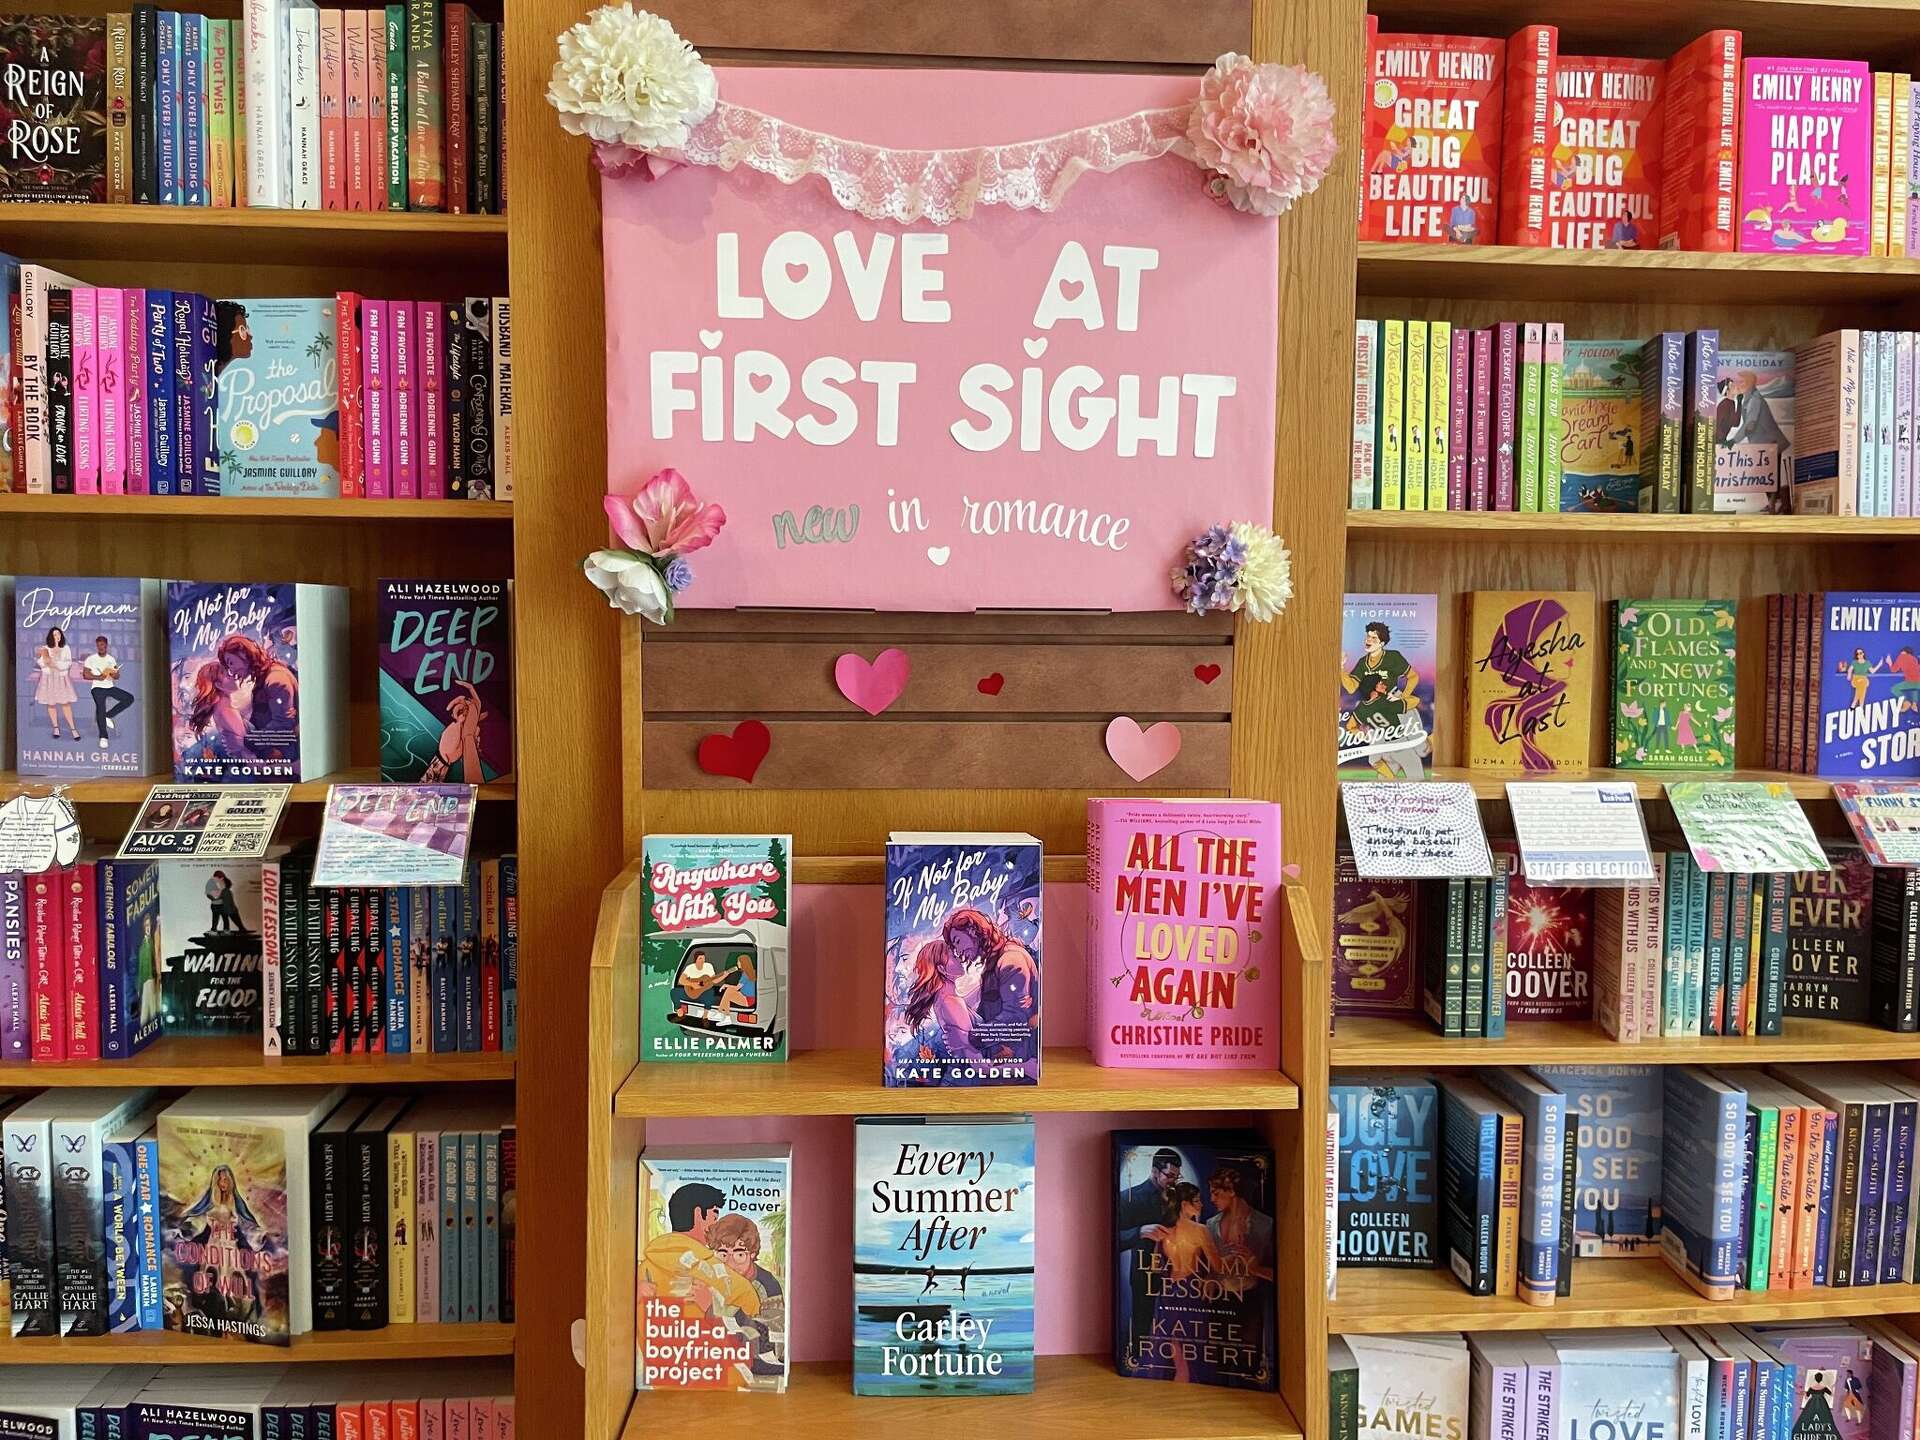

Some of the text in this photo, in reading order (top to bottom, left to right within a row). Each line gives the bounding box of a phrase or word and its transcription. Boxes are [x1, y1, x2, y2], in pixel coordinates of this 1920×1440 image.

[423, 2, 433, 50] REYNA
[40, 46, 51, 63] A
[1374, 49, 1496, 81] EMILY HENRY
[4, 63, 85, 107] REIGN
[1533, 30, 1550, 145] GREAT BIG BEAUTIFUL LIFE
[1751, 74, 1863, 103] EMILY HENRY
[35, 102, 55, 119] OF
[1394, 97, 1480, 131] GREAT
[7, 119, 82, 163] ROSE
[391, 86, 401, 185] BREAKUP VACATION
[1770, 115, 1843, 150] HAPPY
[301, 126, 309, 186] HANNAH GRACE
[1410, 136, 1462, 169] BIG
[1770, 151, 1841, 188] PLACE
[1369, 174, 1493, 205] BEAUTIFUL
[1384, 204, 1444, 238] LIFE
[23, 270, 35, 319] GUILLORY
[716, 230, 1160, 332] LOVE AT
[150, 303, 167, 340] Party
[175, 300, 192, 380] Royal Holiday
[152, 350, 166, 375] Two
[265, 357, 299, 381] the
[498, 303, 513, 417] HUSBAND MATERIAL
[1735, 357, 1787, 369] HOLIDAY
[219, 357, 339, 431] Proposal
[343, 369, 354, 398] DATE
[369, 309, 381, 467] FAN FAVORITE ADRIENNE GUNN
[1356, 335, 1369, 427] KRISTAN HIGGINS
[24, 354, 41, 442] BY THE BOOK
[452, 413, 461, 471] TAYLOR HAHN
[1727, 449, 1770, 469] This Is
[243, 466, 318, 485] JASMINE GUILLORY
[773, 488, 1130, 550] new in romance
[387, 583, 501, 594] ALI HAZELWOOD
[22, 586, 139, 632] Daydream
[173, 586, 252, 635] If Not for
[1360, 609, 1417, 618] HOFFMAN
[1647, 611, 1705, 637] OLD
[1830, 606, 1883, 632] EMILY
[192, 601, 272, 653] My Baby
[390, 606, 499, 654] DEEP
[1474, 620, 1586, 684] Ayesha
[1634, 636, 1721, 658] FLAMES
[413, 649, 496, 695] END
[1518, 662, 1555, 698] at
[1629, 658, 1714, 681] AND NEW
[1624, 680, 1729, 699] FORTUNES
[1498, 699, 1571, 745] Last
[1824, 695, 1905, 745] FUNNY
[22, 749, 139, 765] HANNAH GRACE
[184, 764, 294, 777] KATE GOLDEN
[1648, 754, 1704, 763] SARAH HOGLE
[134, 833, 197, 848] AUG. 8
[202, 839, 225, 848] INFO
[204, 831, 233, 841] MORE
[1358, 824, 1397, 841] They
[1365, 835, 1461, 853] enough baseball
[1124, 832, 1258, 878] ALL THE
[1367, 848, 1381, 861] in
[1382, 850, 1400, 861] one
[1403, 847, 1418, 860] of
[1529, 861, 1651, 877] STAFF SELECTION
[651, 858, 759, 895] Anywhere
[893, 850, 988, 907] If Not for
[654, 891, 773, 927] With You
[912, 867, 1009, 930] My Baby
[1114, 875, 1188, 917] MEN
[3, 879, 21, 960] PANSIES
[104, 865, 117, 970] SOMETHING FABULOUS
[262, 868, 279, 967] LOVE LESSONS
[329, 896, 340, 955] UNRAVELING
[1135, 921, 1240, 965] LOVED
[1506, 952, 1573, 973] COLLEEN
[1129, 965, 1238, 1010] AGAIN
[1768, 947, 1781, 1014] COLLEEN HOOVER
[194, 988, 258, 1009] FLOOD
[653, 1037, 774, 1051] ELLIE PALMER
[1109, 1025, 1264, 1047] CHRISTINE PRIDE
[896, 1067, 1025, 1080] KATE GOLDEN
[1577, 1094, 1613, 1119] SO
[893, 1142, 995, 1185] Every
[1540, 1104, 1557, 1238] SO GOOD TO SEE YOU
[1592, 1157, 1641, 1181] SEE
[728, 1199, 781, 1213] Deaver
[731, 1184, 781, 1198] Mason
[871, 1179, 1019, 1214] Summer
[113, 1203, 125, 1238] WORLD
[1350, 1211, 1410, 1228] COLLEEN
[143, 1215, 157, 1273] ROMANCE
[897, 1215, 988, 1262] After
[1337, 1230, 1429, 1258] HOOVER
[174, 1240, 273, 1271] CONDITIONS
[1136, 1249, 1257, 1278] LEAN MY
[13, 1291, 49, 1301] CALLIE
[1144, 1270, 1244, 1303] LESSON
[13, 1300, 50, 1311] HART
[645, 1300, 681, 1318] the
[185, 1313, 268, 1338] JESSA HASTINGS
[645, 1319, 737, 1340] build-a-
[895, 1309, 994, 1350] Carley
[1152, 1317, 1243, 1343] KATEE
[645, 1341, 751, 1365] boyfriend
[880, 1345, 1003, 1378] Fortune
[1138, 1339, 1257, 1368] ROBERT
[645, 1363, 724, 1386] project
[140, 1407, 247, 1425] ALI HAZELWOOD
[1570, 1418, 1665, 1440] LOVE
[1690, 1405, 1702, 1435] LOVE
